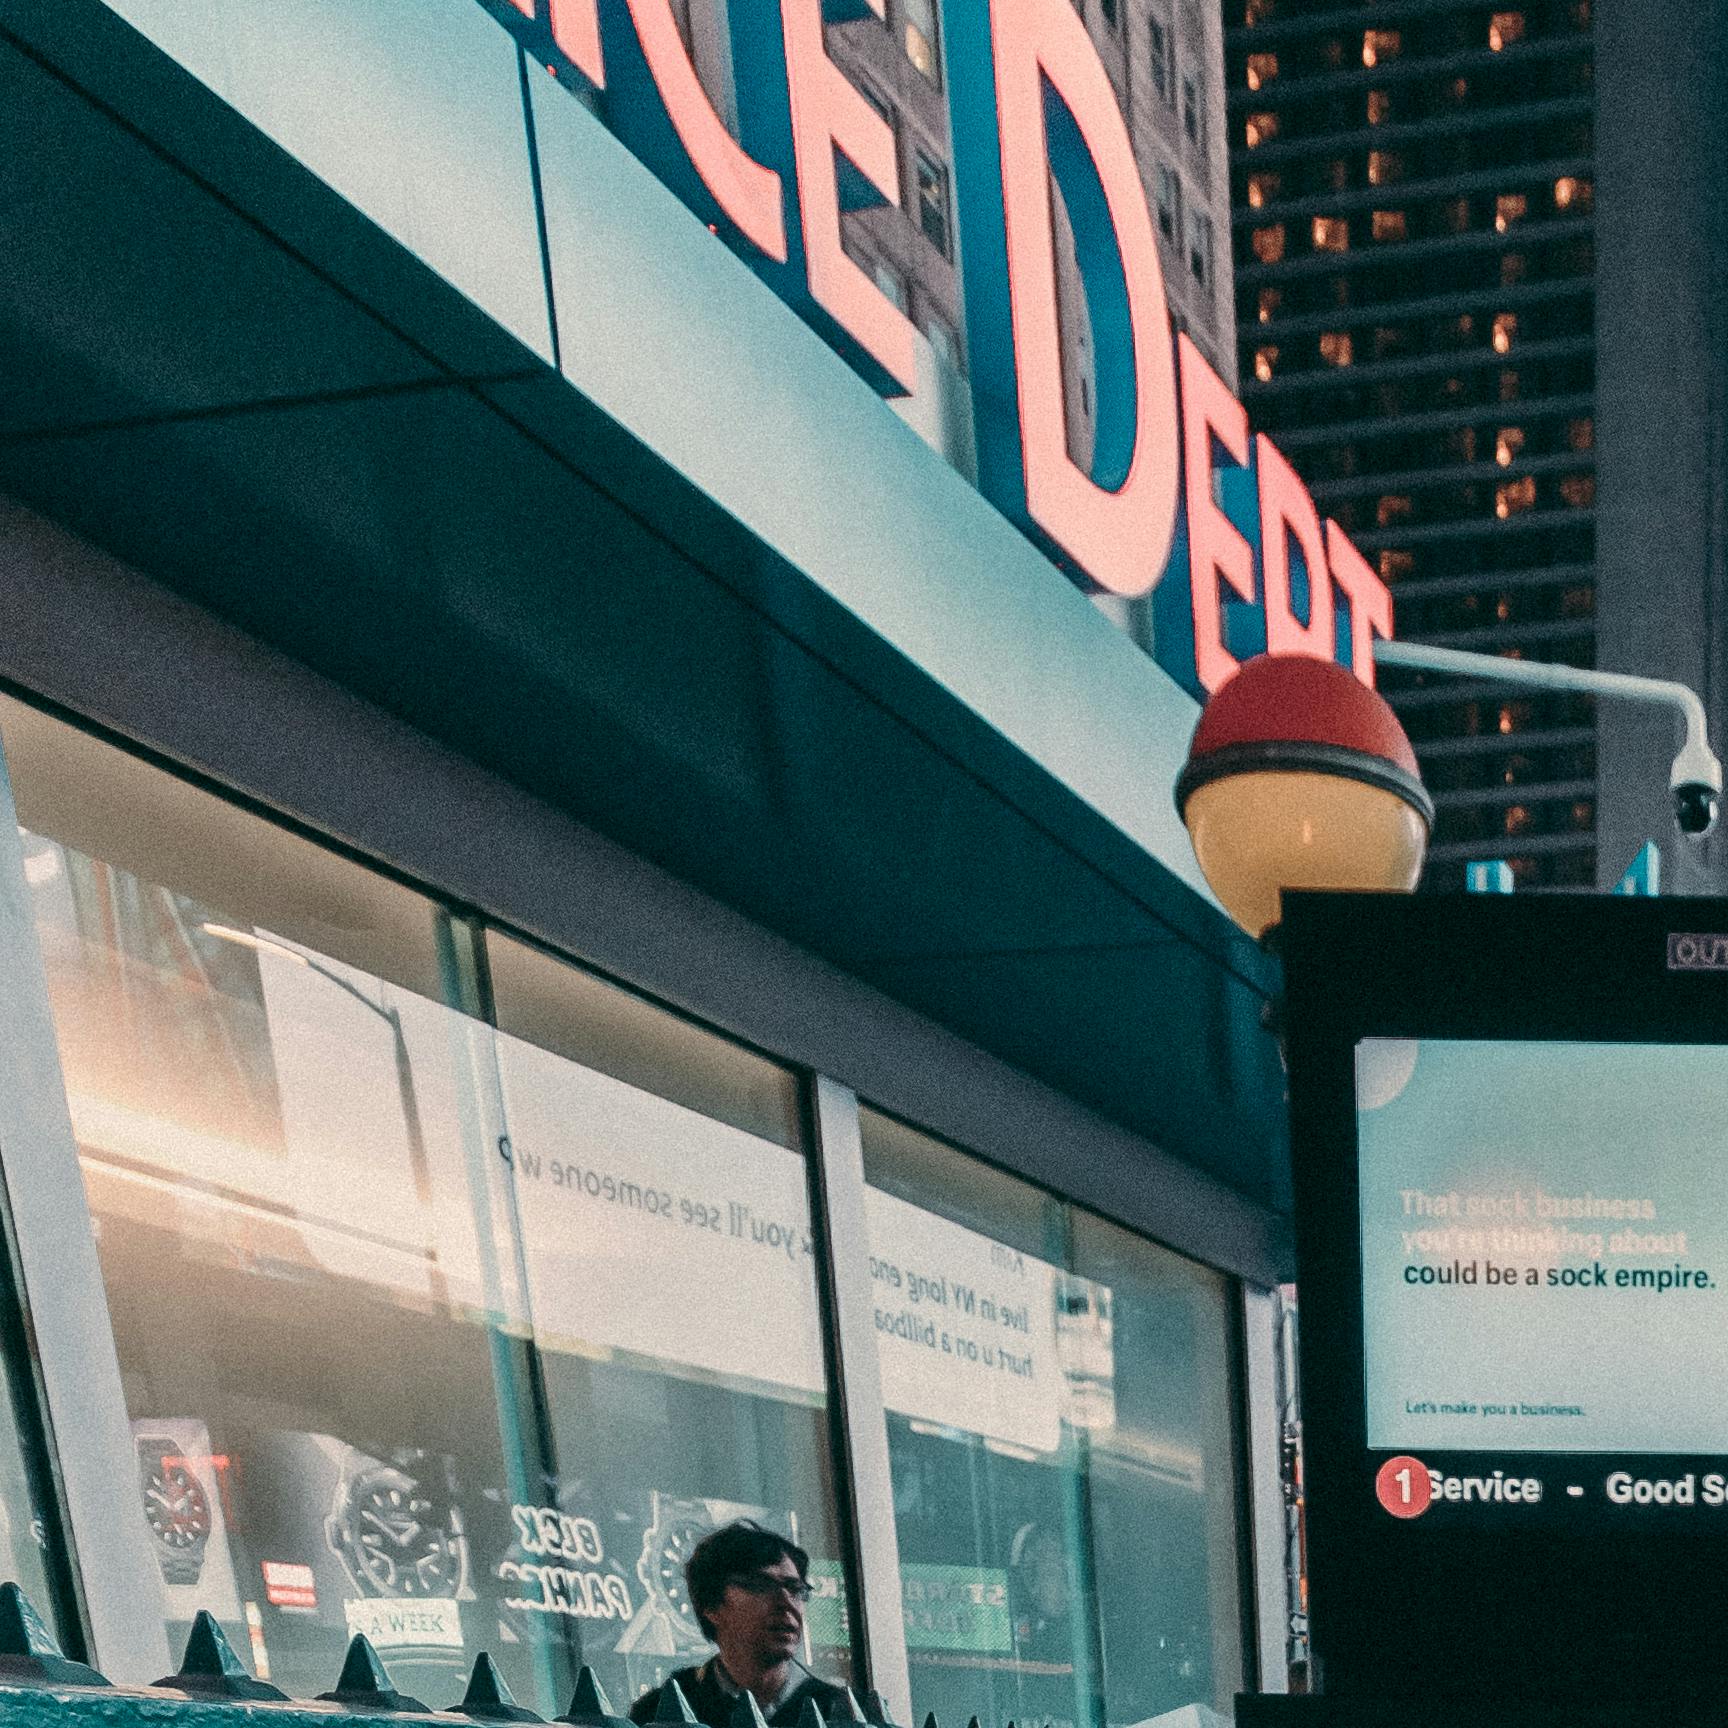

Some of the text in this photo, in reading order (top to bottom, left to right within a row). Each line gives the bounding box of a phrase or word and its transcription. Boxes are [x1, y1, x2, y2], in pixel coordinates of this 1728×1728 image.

[1399, 1189, 1461, 1216] That
[1536, 1191, 1657, 1219] business
[1609, 1227, 1688, 1254] about
[1403, 1259, 1717, 1293] could be a sock empire.
[1405, 1400, 1586, 1418] Let's make you a business.
[1394, 1467, 1412, 1504] 1
[1428, 1469, 1542, 1503] Service
[1606, 1470, 1697, 1505] Good
[388, 1611, 446, 1633] WEEK
